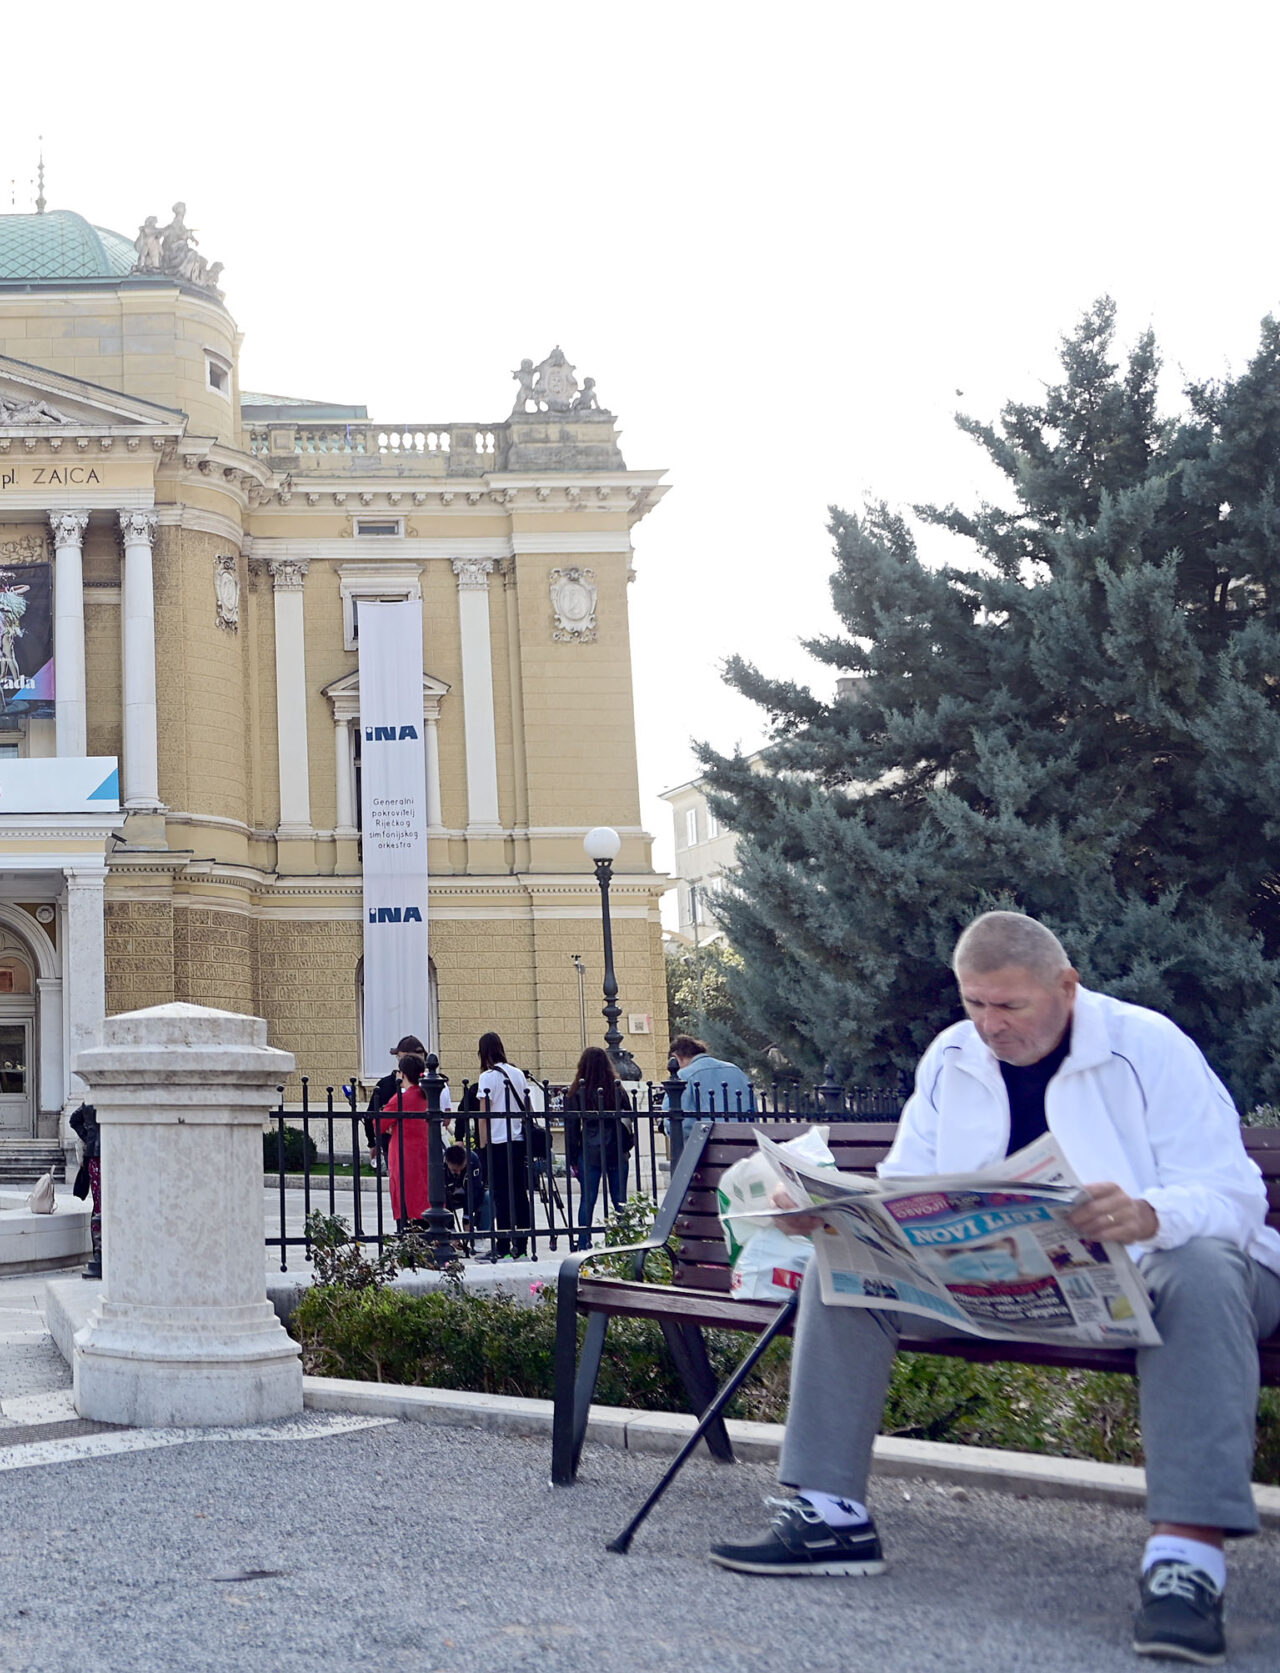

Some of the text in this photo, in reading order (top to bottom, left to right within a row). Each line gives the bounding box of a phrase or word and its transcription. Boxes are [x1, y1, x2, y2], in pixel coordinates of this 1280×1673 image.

[32, 467, 101, 485] ZAJCA
[373, 797, 415, 806] Generalni
[371, 809, 416, 818] pokrovitelj
[369, 830, 419, 840] simfonijskog
[377, 841, 412, 849] orkestra
[910, 1208, 1042, 1244] NOVI LIST
